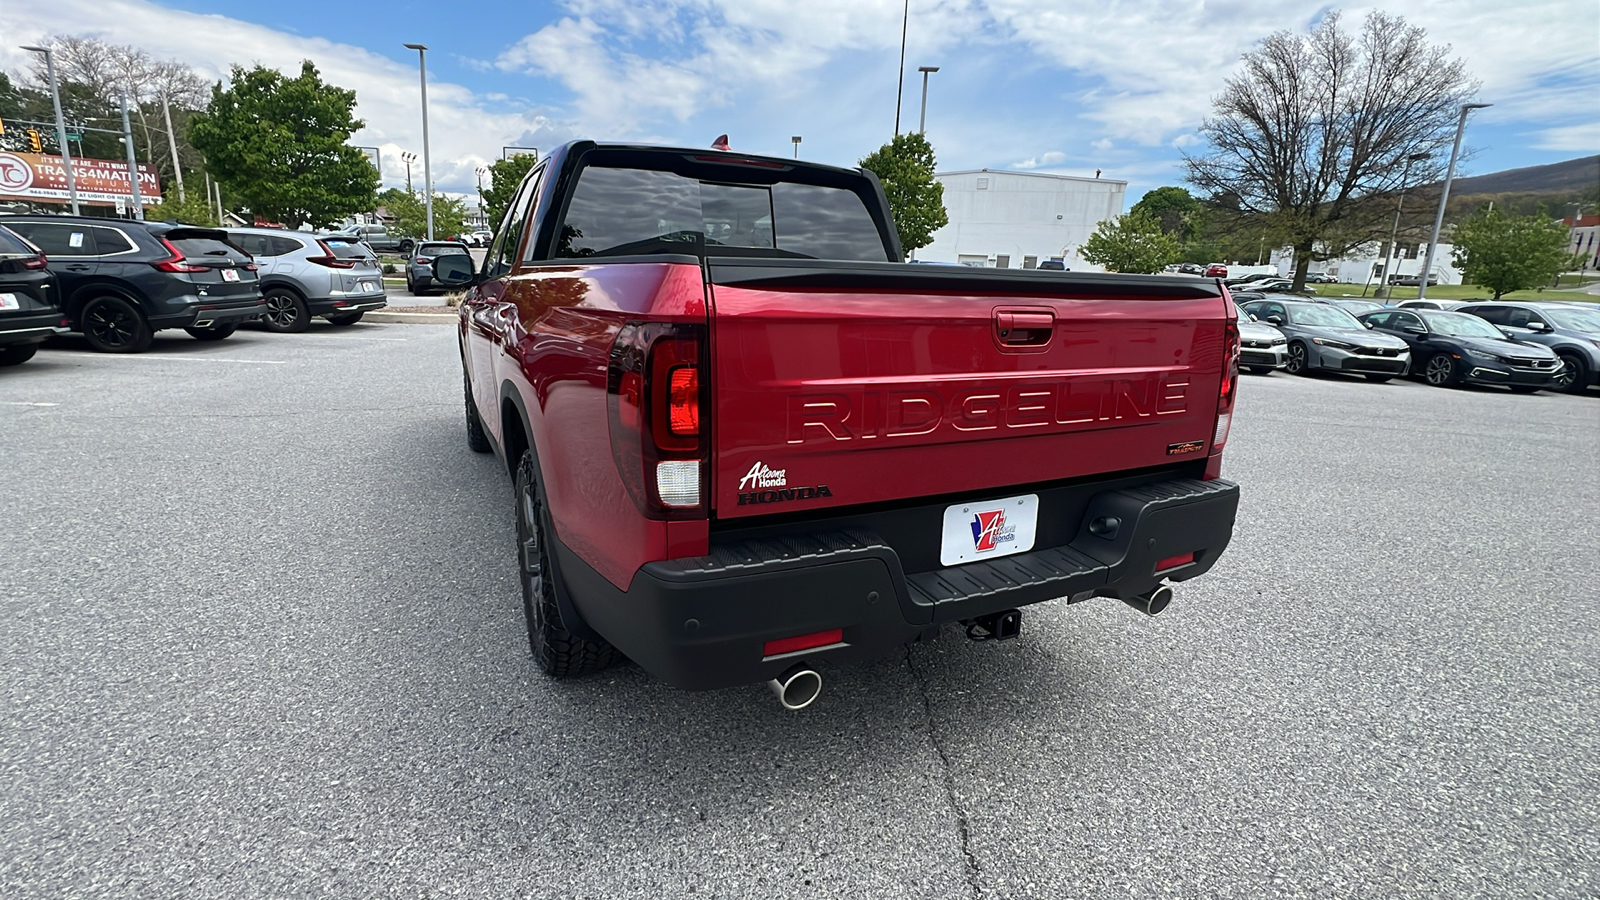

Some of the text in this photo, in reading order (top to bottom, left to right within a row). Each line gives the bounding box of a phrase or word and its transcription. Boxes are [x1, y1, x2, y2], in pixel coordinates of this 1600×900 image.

[41, 156, 53, 164] IT'S
[98, 161, 110, 169] IT'S
[111, 162, 128, 170] WHAT
[785, 374, 1191, 445] RIDGELINE
[738, 461, 787, 490] Altoona
[758, 477, 787, 488] Honda
[737, 485, 834, 506] HONDA
